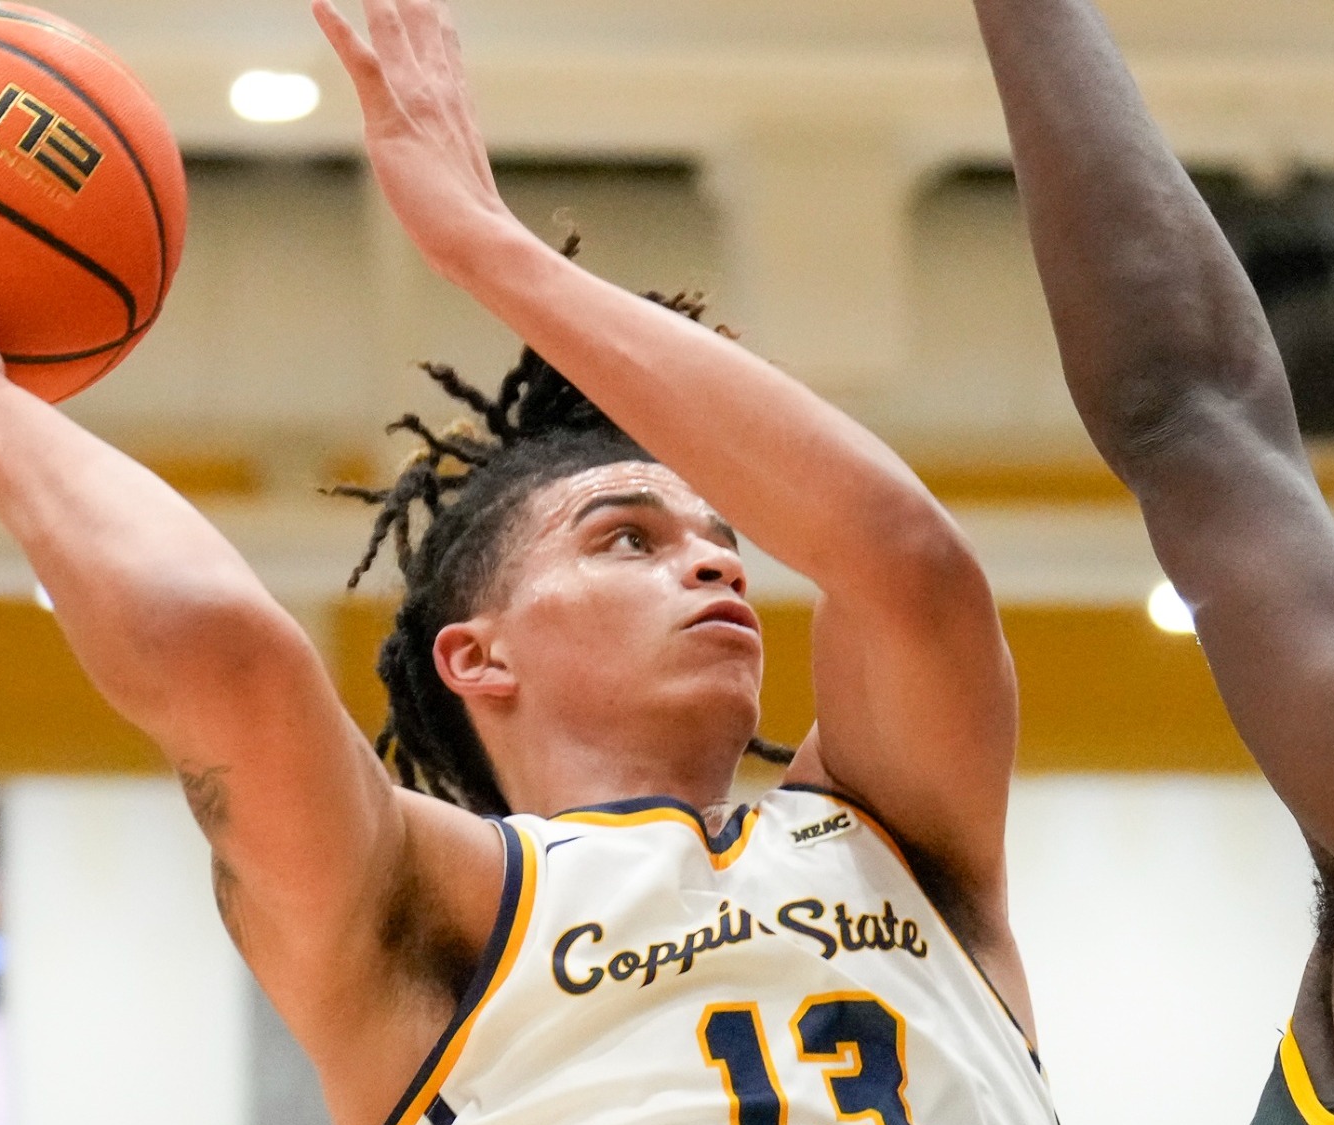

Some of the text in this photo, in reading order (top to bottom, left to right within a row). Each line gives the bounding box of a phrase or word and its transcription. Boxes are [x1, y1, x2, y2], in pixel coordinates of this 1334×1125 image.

[791, 811, 852, 843] MEAC
[552, 897, 929, 995] Coppin State
